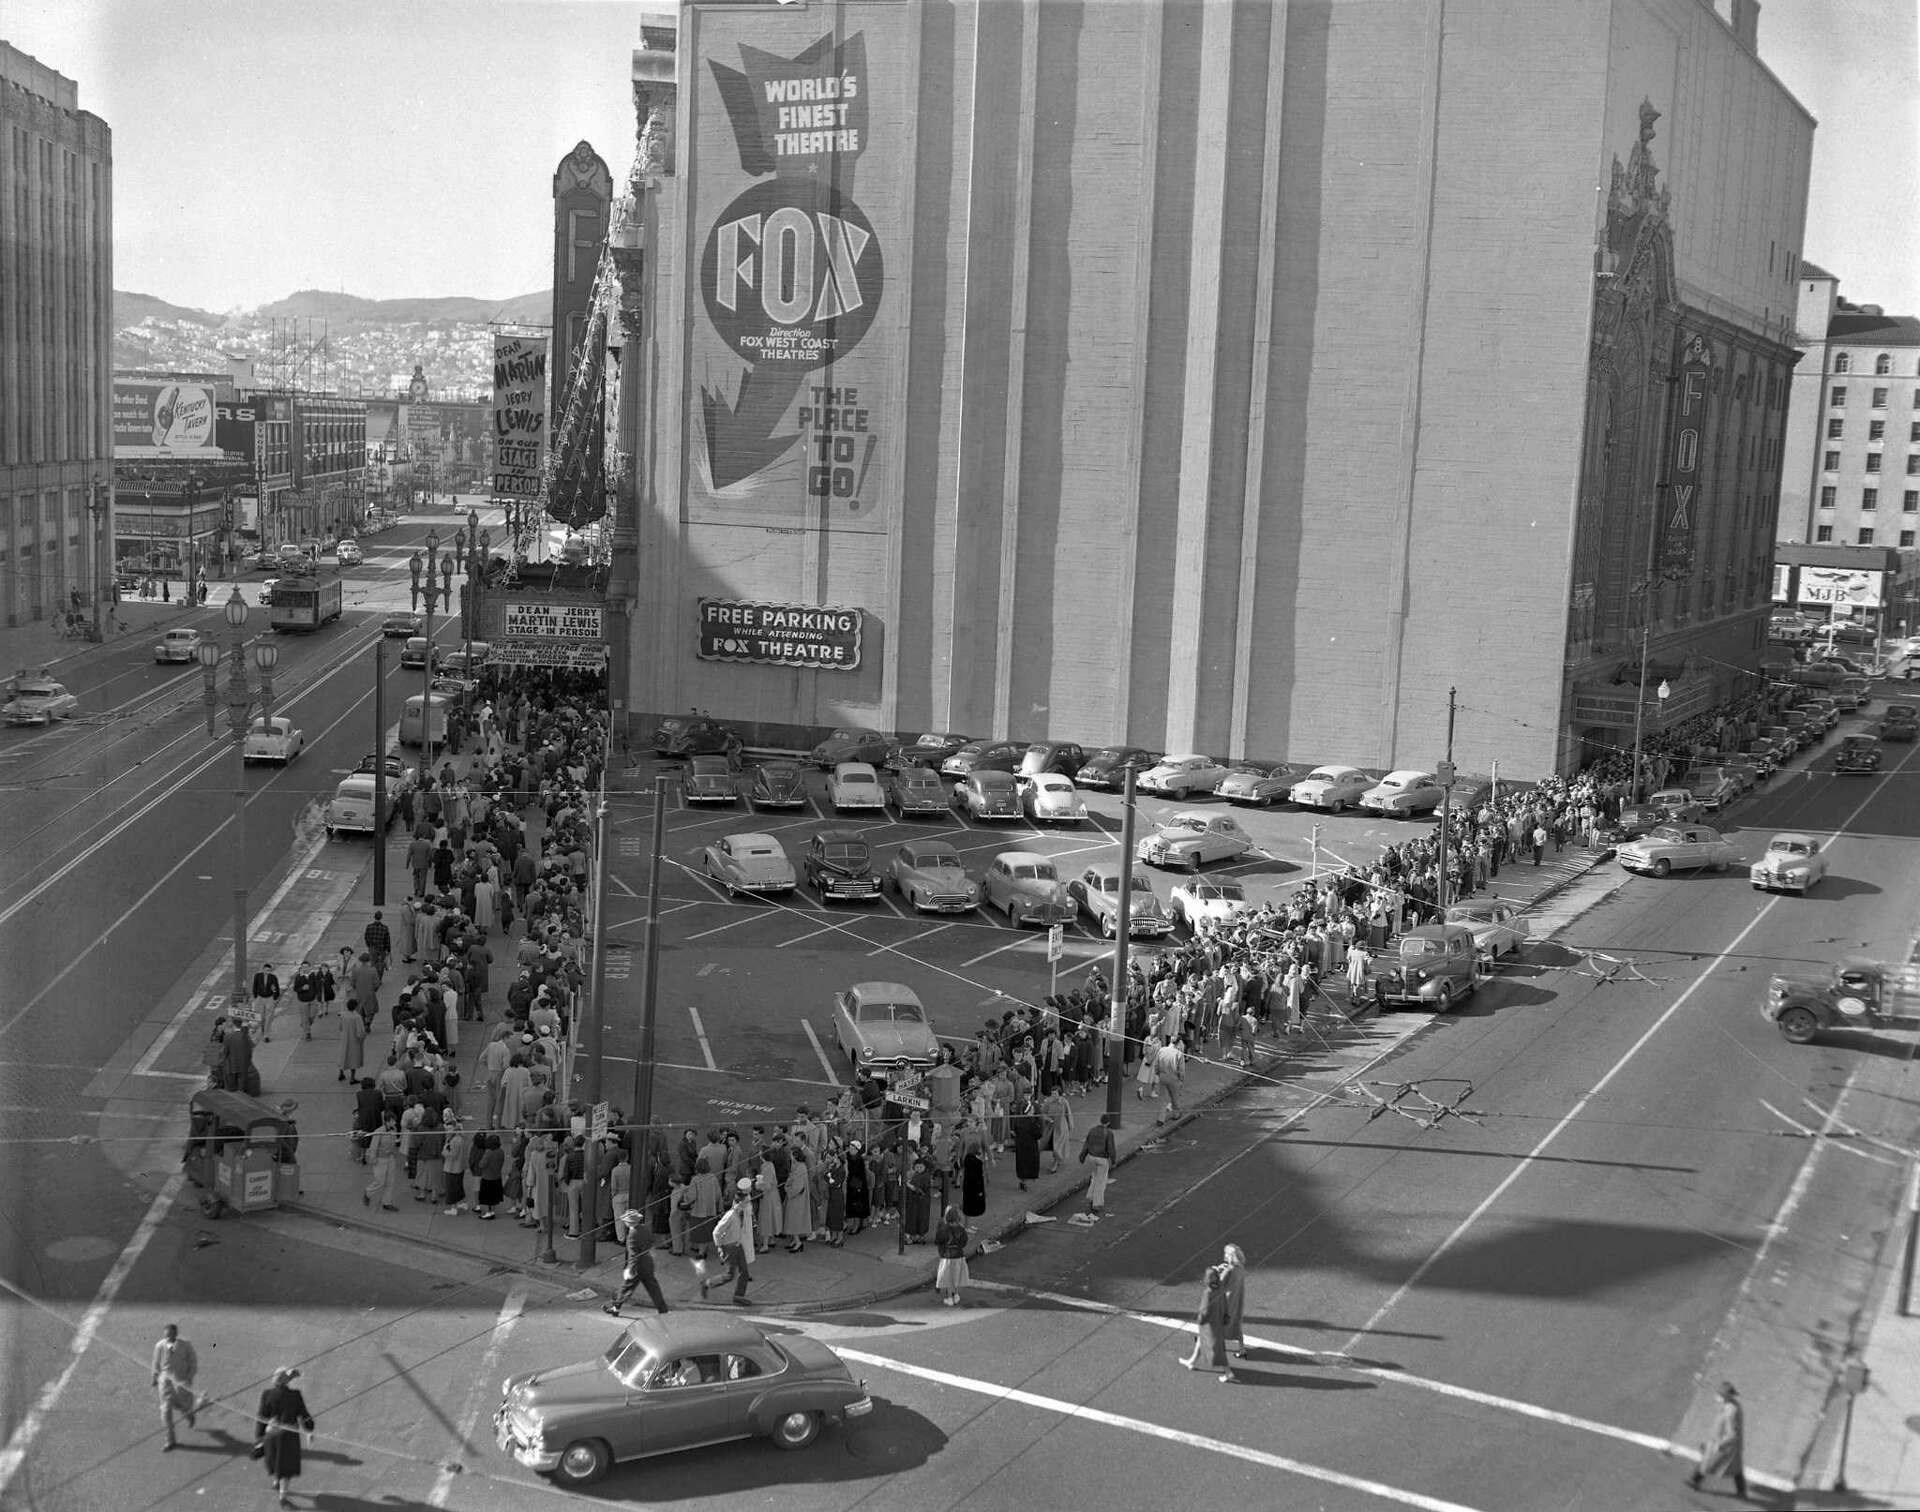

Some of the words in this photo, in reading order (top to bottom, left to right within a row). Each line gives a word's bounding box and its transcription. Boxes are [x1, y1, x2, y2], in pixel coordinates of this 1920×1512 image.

[765, 69, 857, 102] WORLD'S
[779, 103, 848, 129] FINEST
[774, 129, 858, 155] THEATRE
[717, 207, 870, 324] FOX
[769, 327, 811, 338] Direction
[496, 340, 522, 360] DEAN
[740, 336, 764, 347] FOX
[766, 337, 797, 348] WEST
[801, 338, 839, 349] COAST
[760, 349, 819, 360] THEATRES
[494, 351, 546, 390] MARTIN
[811, 386, 858, 405] THE
[496, 408, 544, 436] LEWIS
[798, 407, 868, 432] PLACE
[498, 438, 514, 446] ON
[813, 435, 854, 463] TO
[1669, 371, 1706, 529] FOX
[501, 451, 537, 467] STAGE
[496, 476, 540, 495] PERSON
[518, 606, 550, 615] DEAN
[565, 608, 597, 617] JERRY
[707, 607, 754, 625] FREE
[762, 610, 851, 632] PARKING
[508, 615, 557, 627] MARTIN
[563, 617, 599, 628] LEWIS
[508, 626, 539, 634] STAGE
[546, 627, 556, 635] IN
[559, 628, 598, 637] PERSON
[733, 627, 763, 636] WHILE
[768, 630, 823, 640] ATTENDING
[713, 637, 750, 653] FOX
[758, 640, 844, 660] THEATRE
[706, 1098, 776, 1113] PARKING
[893, 1094, 921, 1107] LARKIN
